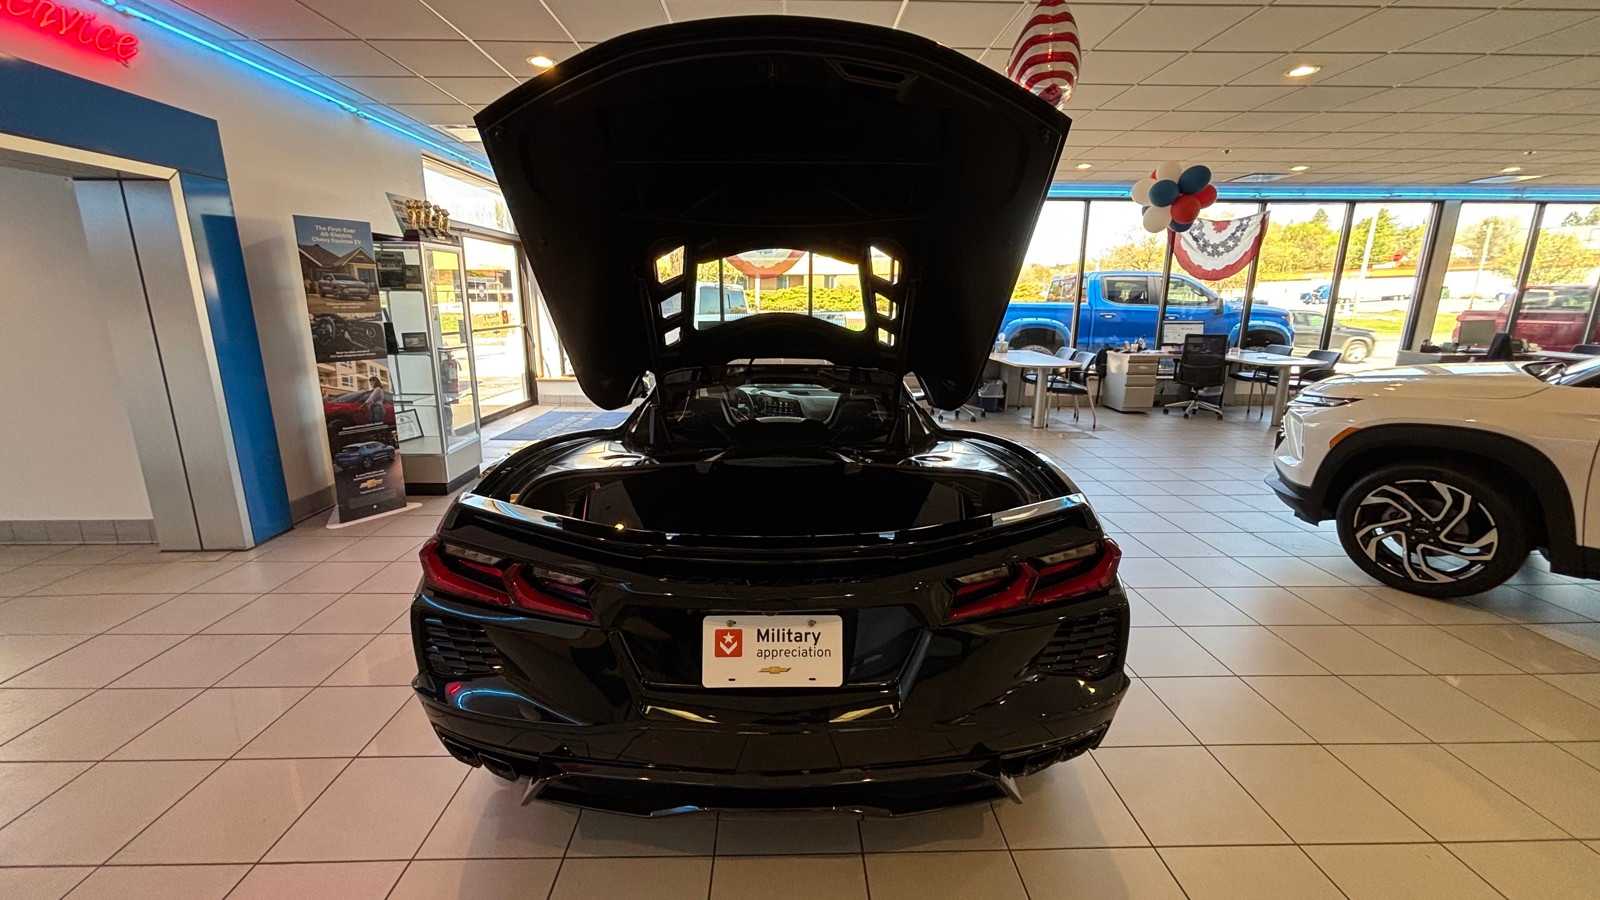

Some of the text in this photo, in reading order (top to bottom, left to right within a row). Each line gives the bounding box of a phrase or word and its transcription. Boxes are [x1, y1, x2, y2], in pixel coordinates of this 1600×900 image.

[0, 0, 138, 60] ervice
[756, 628, 822, 646] Military
[756, 647, 832, 660] appreciation
